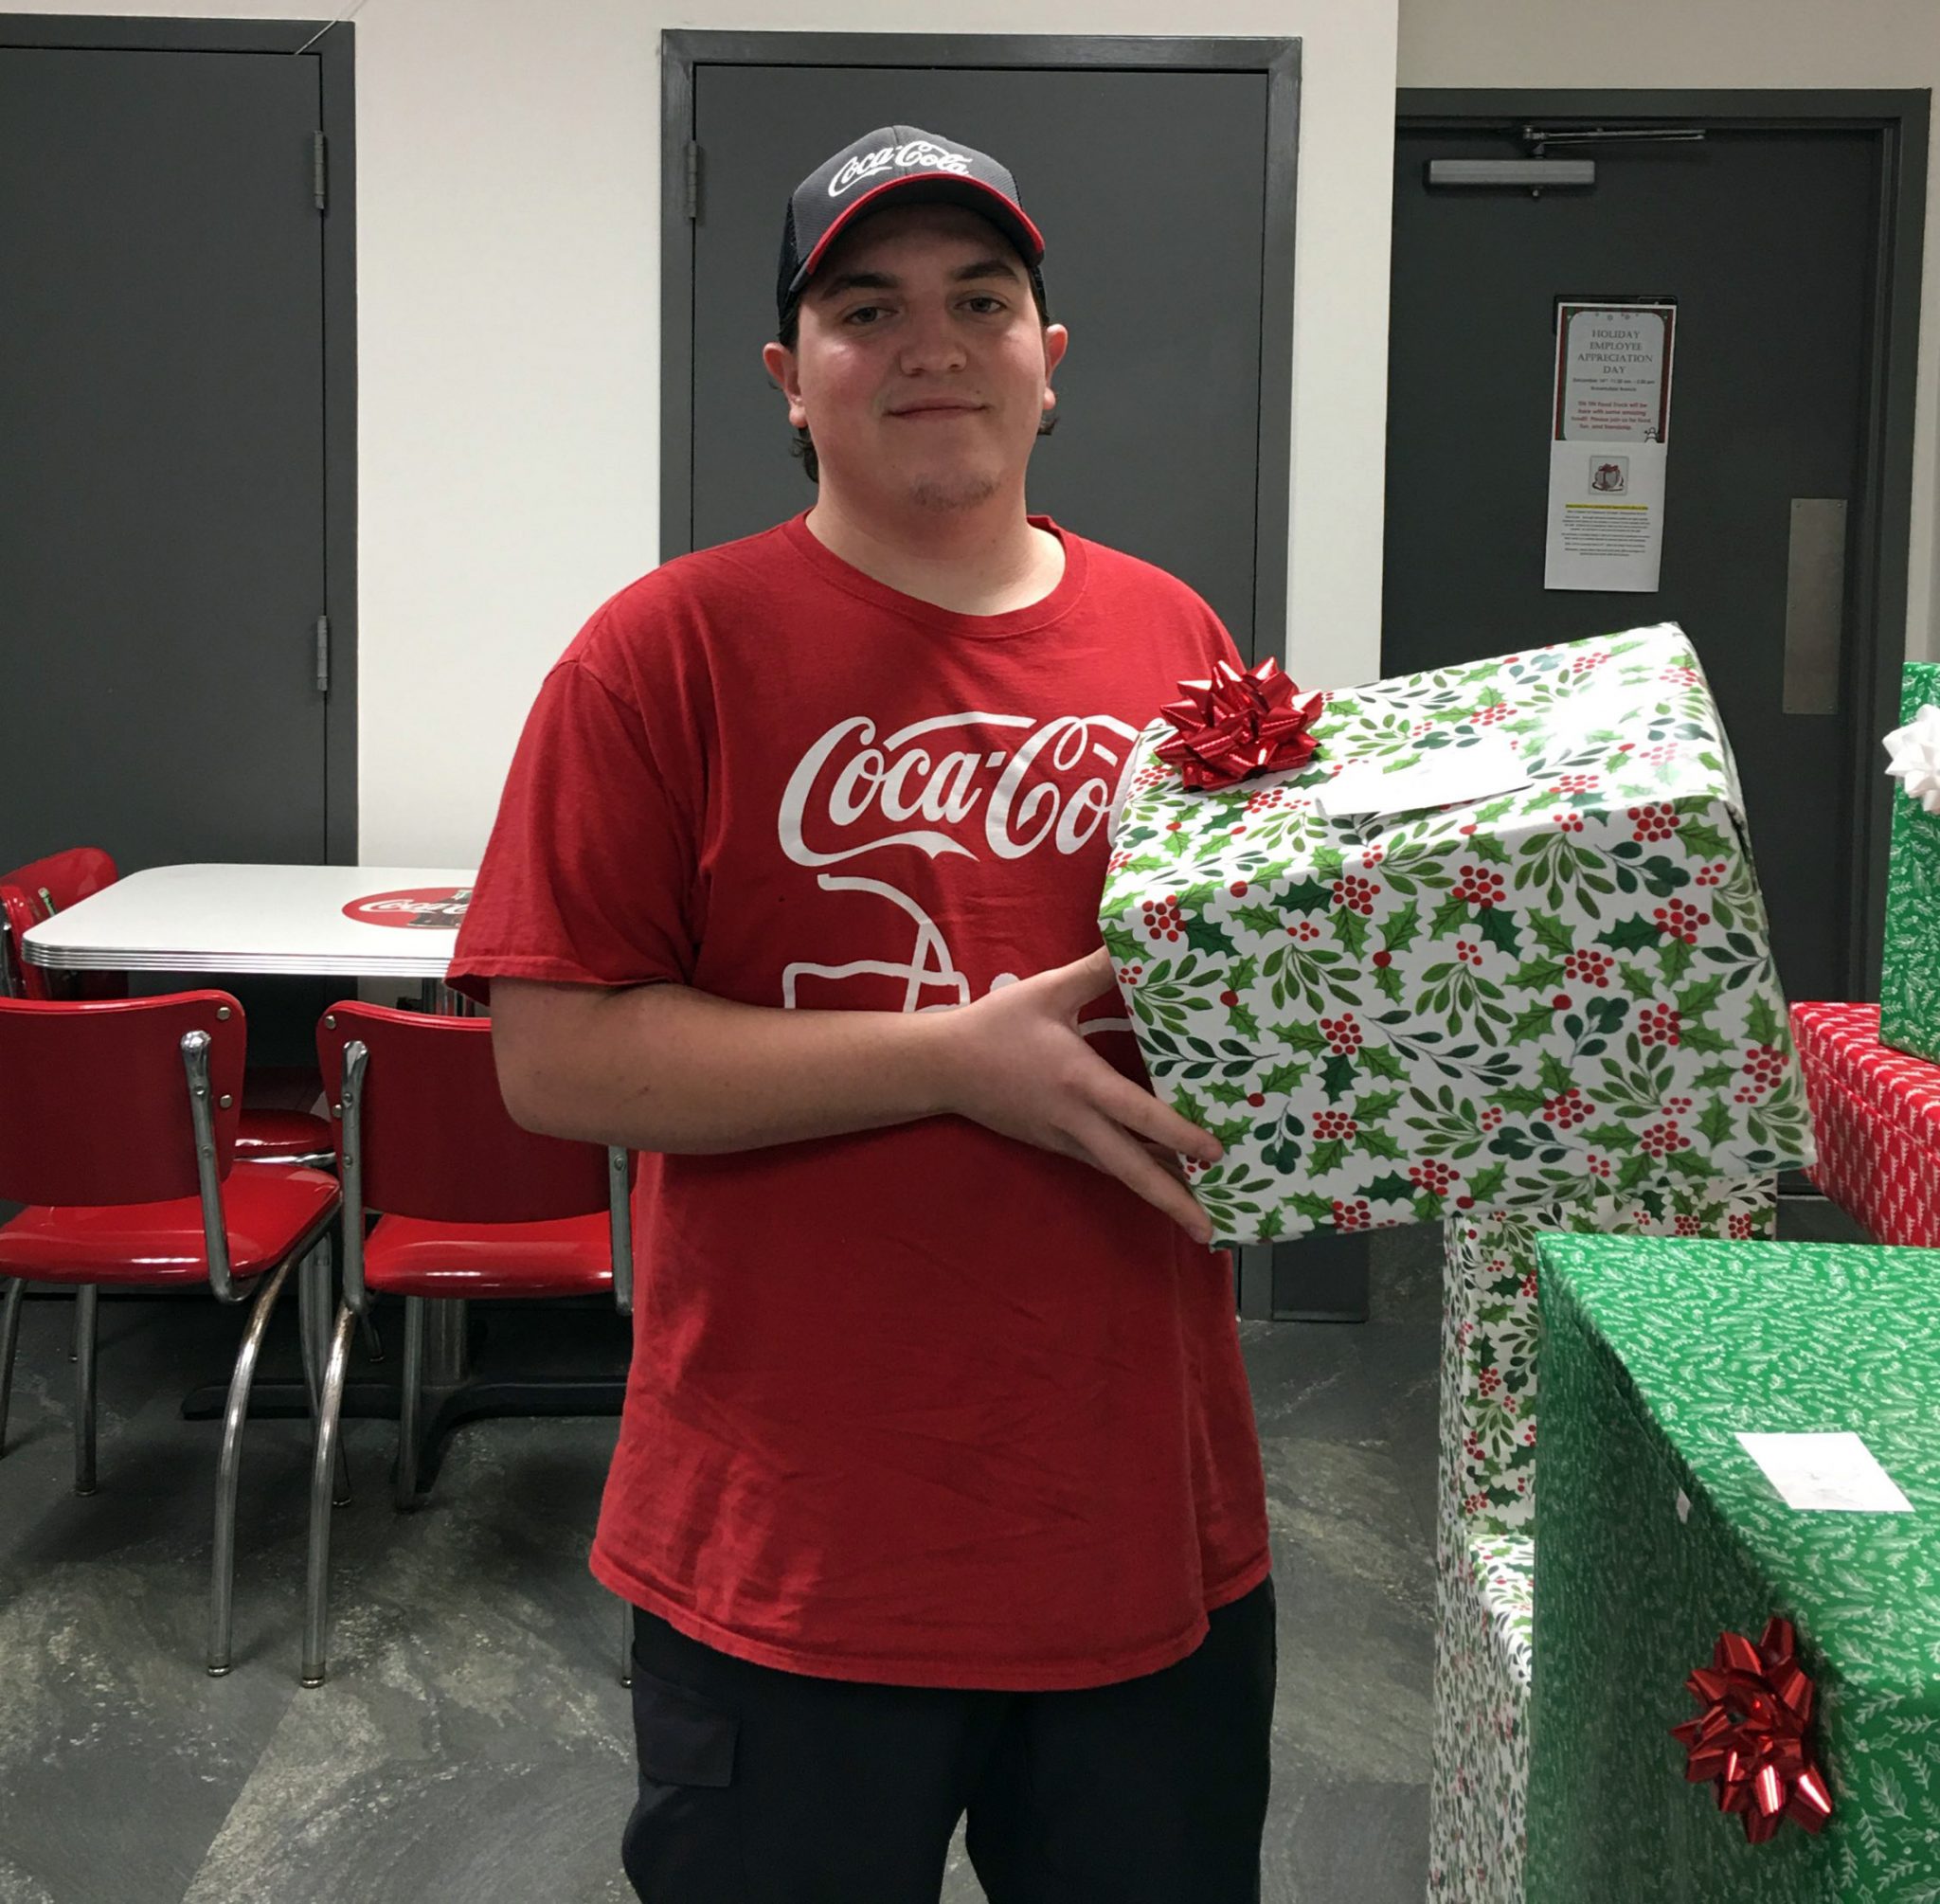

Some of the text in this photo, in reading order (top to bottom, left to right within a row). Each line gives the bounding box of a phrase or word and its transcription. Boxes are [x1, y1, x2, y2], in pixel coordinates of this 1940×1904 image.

[828, 140, 973, 197] Coca-Cola
[1591, 330, 1641, 339] HOLIDAY
[1590, 341, 1643, 350] EMPLOYEE
[1577, 353, 1653, 363] APPRECIATION
[1603, 366, 1626, 374] DAY
[778, 711, 1140, 867] Coca-Co
